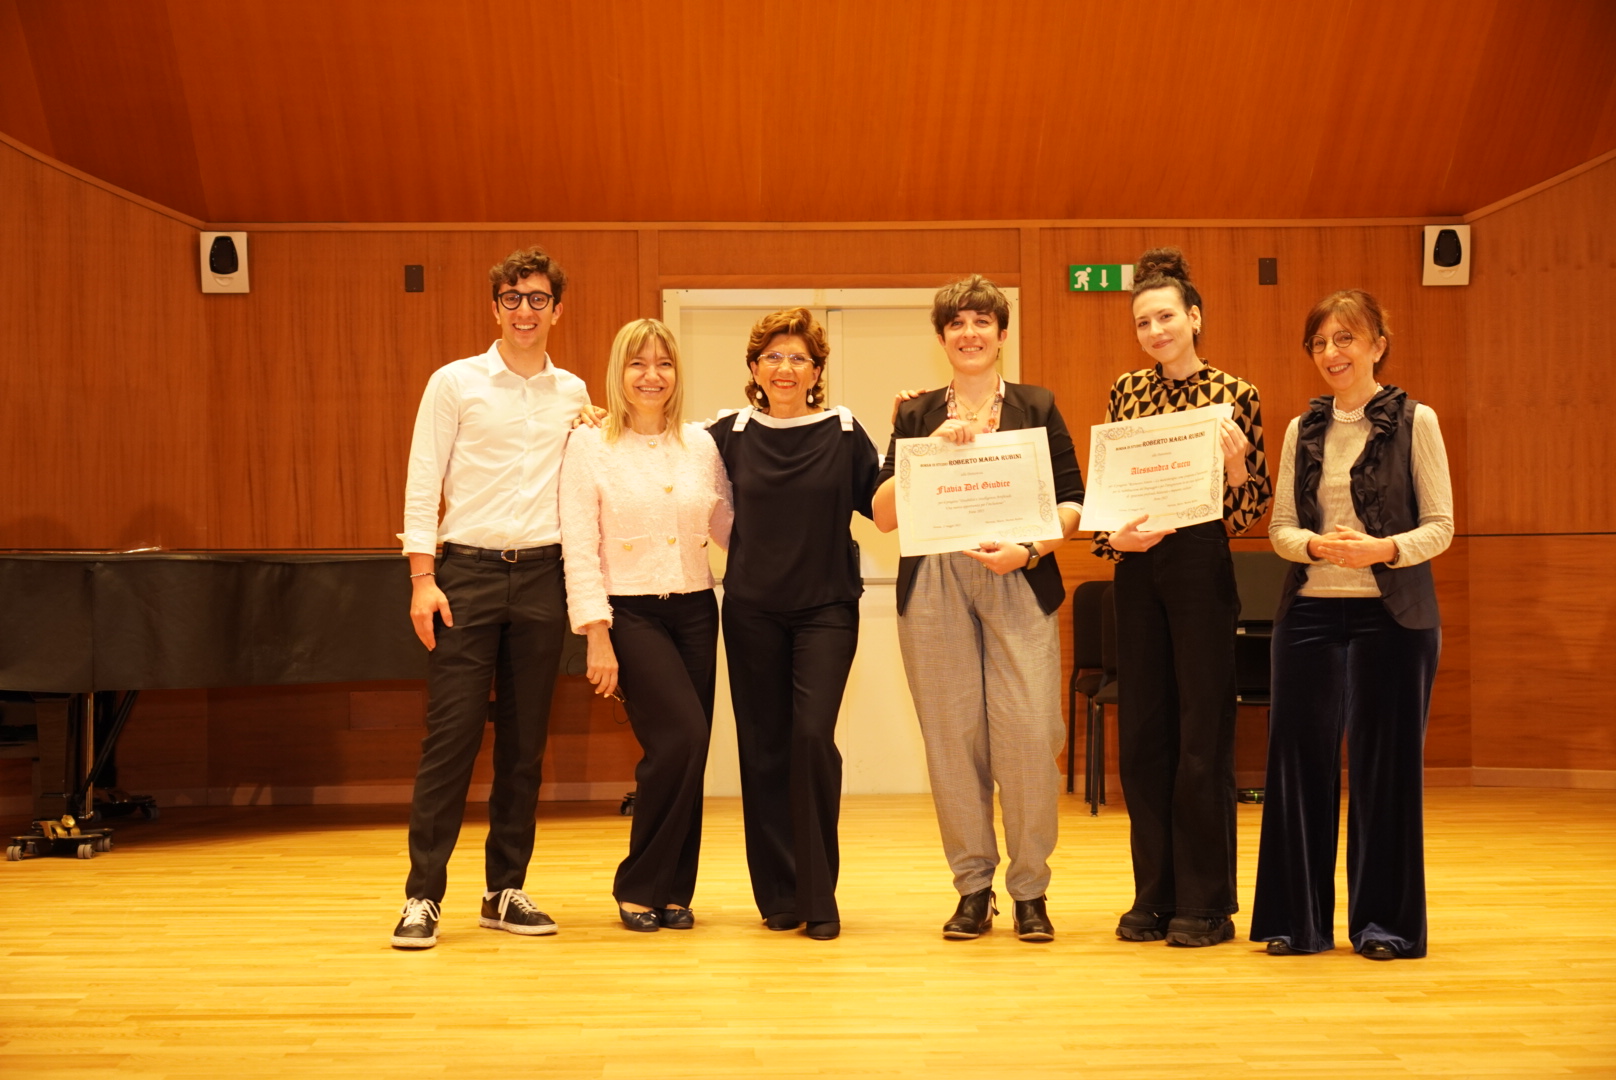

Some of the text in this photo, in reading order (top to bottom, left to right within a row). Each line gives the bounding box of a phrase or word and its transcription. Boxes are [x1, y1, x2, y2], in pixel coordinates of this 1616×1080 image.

[1142, 438, 1168, 447] ROBERTO
[1168, 435, 1188, 443] MARIA
[1188, 431, 1205, 439] RUBINI
[949, 457, 978, 466] ROBERTO
[978, 455, 1000, 463] MARIA
[1130, 464, 1169, 475] Alessandra
[936, 480, 1011, 495] Flavia Del Giudice
